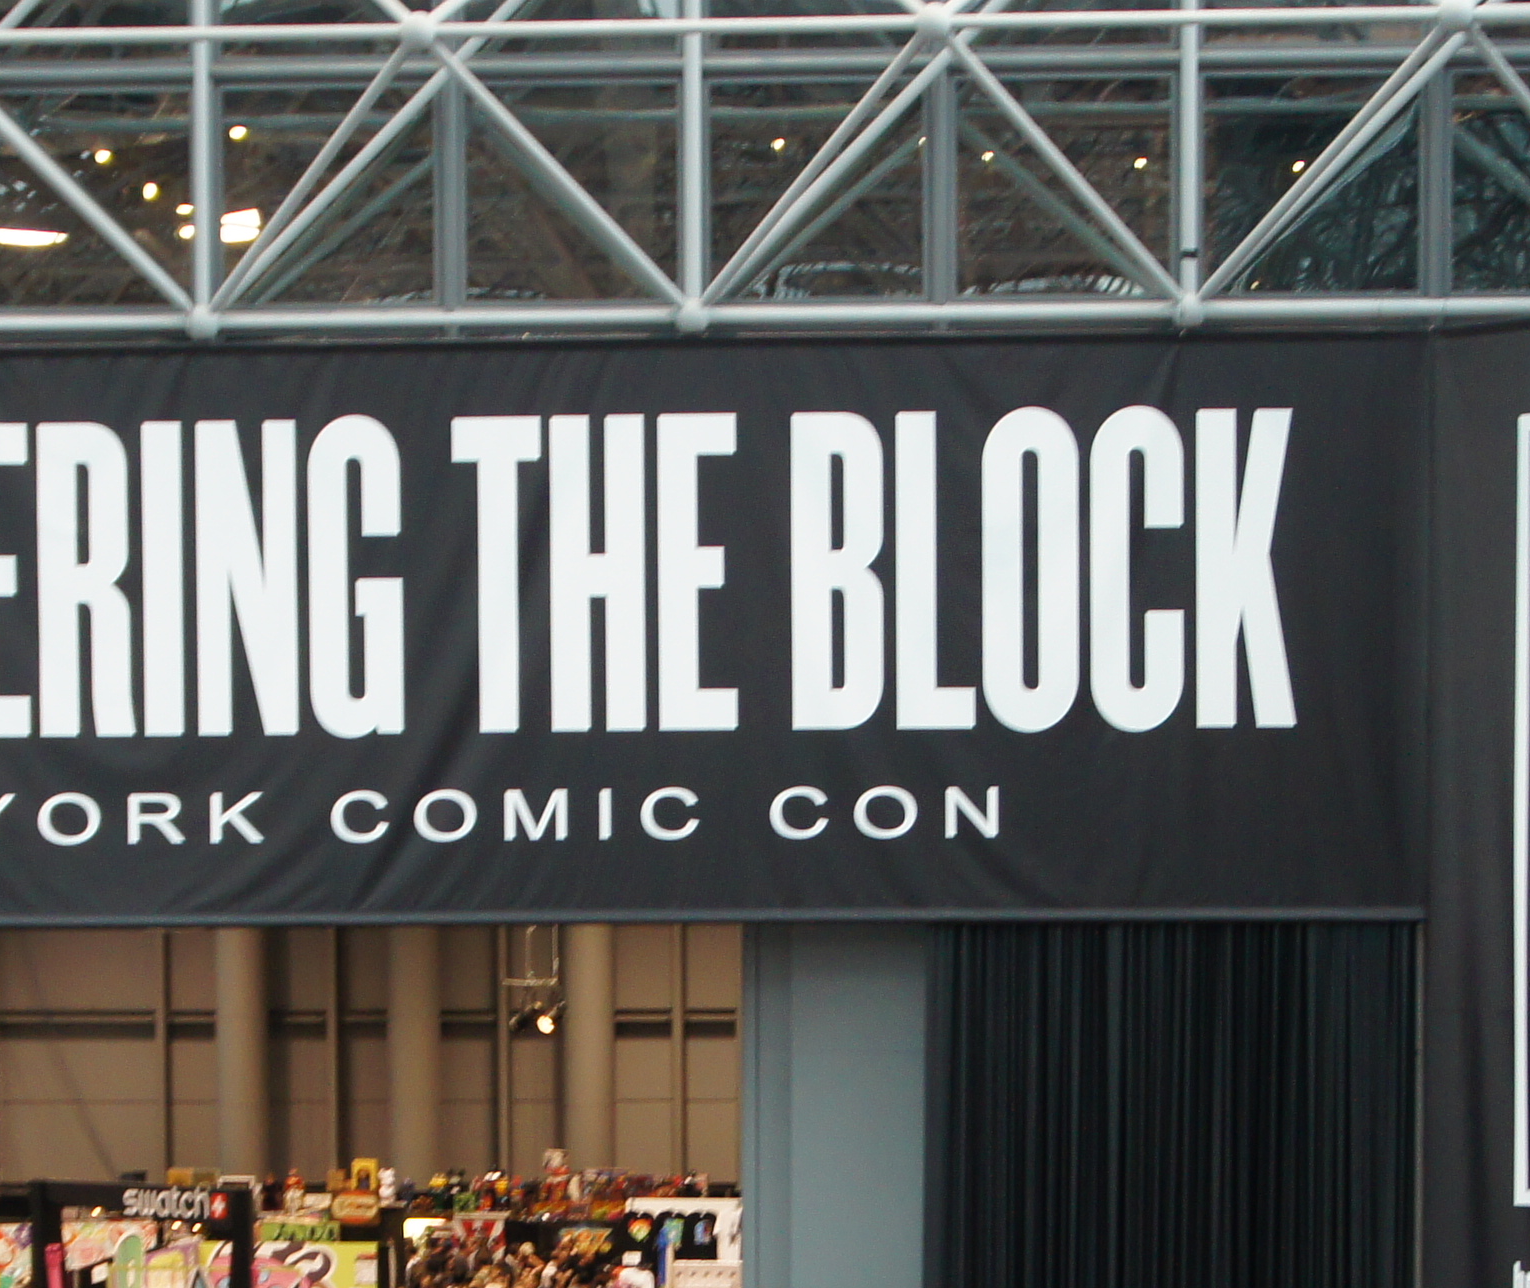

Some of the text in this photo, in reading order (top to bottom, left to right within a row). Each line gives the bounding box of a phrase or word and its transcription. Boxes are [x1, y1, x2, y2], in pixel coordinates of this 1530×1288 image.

[450, 412, 740, 735] THE
[790, 405, 1299, 735] BLOCK
[329, 787, 702, 845] COMIC
[768, 785, 1001, 842] CON
[121, 1185, 211, 1220] swatch
